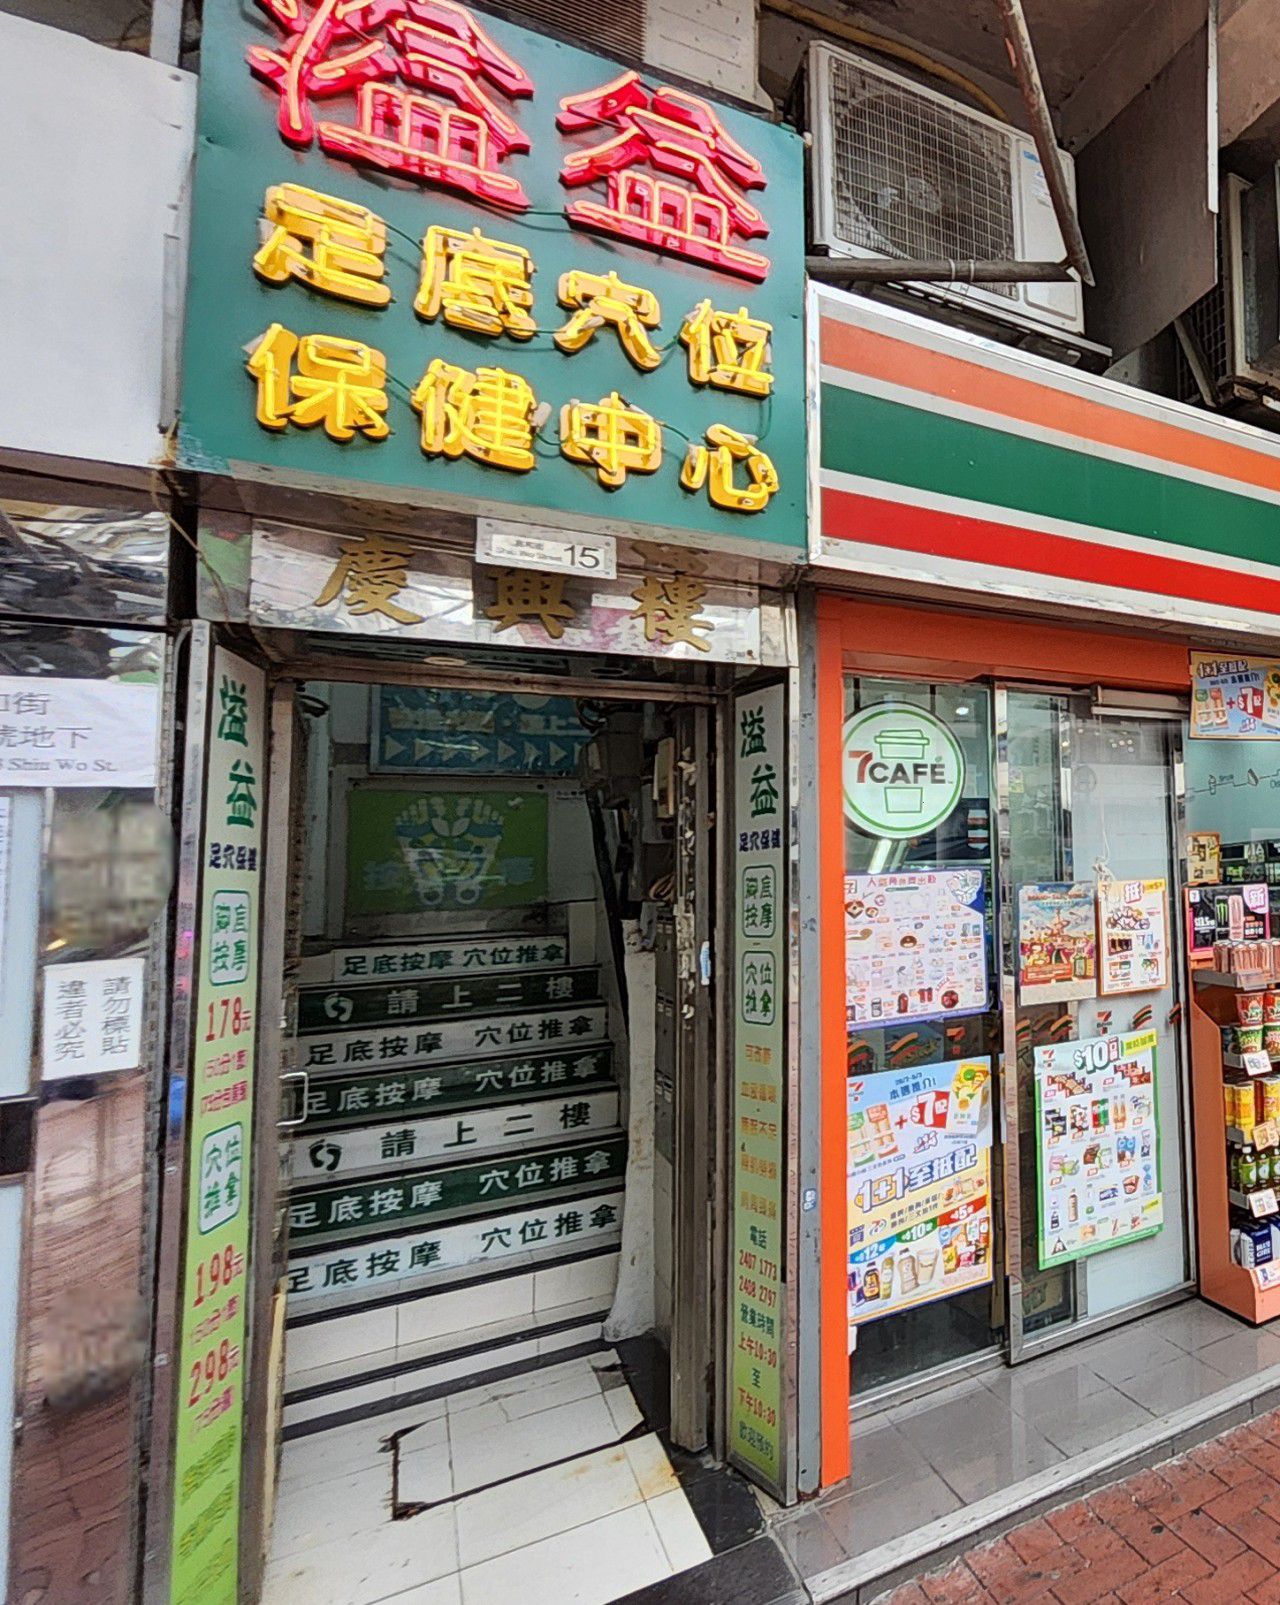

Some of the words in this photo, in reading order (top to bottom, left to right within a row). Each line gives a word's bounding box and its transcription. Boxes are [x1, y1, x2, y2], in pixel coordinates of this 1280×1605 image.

[252, 181, 774, 397] 足底穴位
[243, 321, 778, 513] 保健中心
[564, 545, 601, 569] 15
[218, 674, 257, 828] 溢益
[741, 705, 779, 818] 溢益
[341, 948, 454, 977] 足底按摩
[462, 943, 566, 969] 穴位推拿
[745, 961, 773, 985] 穴位
[101, 976, 132, 1056] 請勿標貼
[386, 976, 575, 1016] 請上二樓
[304, 1031, 444, 1067] 足底按摩
[474, 1014, 595, 1048] 穴位推拿
[305, 1075, 444, 1116] 足底按摩
[474, 1054, 600, 1093] 穴位推拿
[380, 1101, 592, 1160] 請上二樓
[289, 1180, 444, 1230] 足底按摩
[479, 1150, 612, 1196] 穴位推拿
[287, 1240, 442, 1294] 足底按摩
[480, 1203, 618, 1254] 穴位推拿
